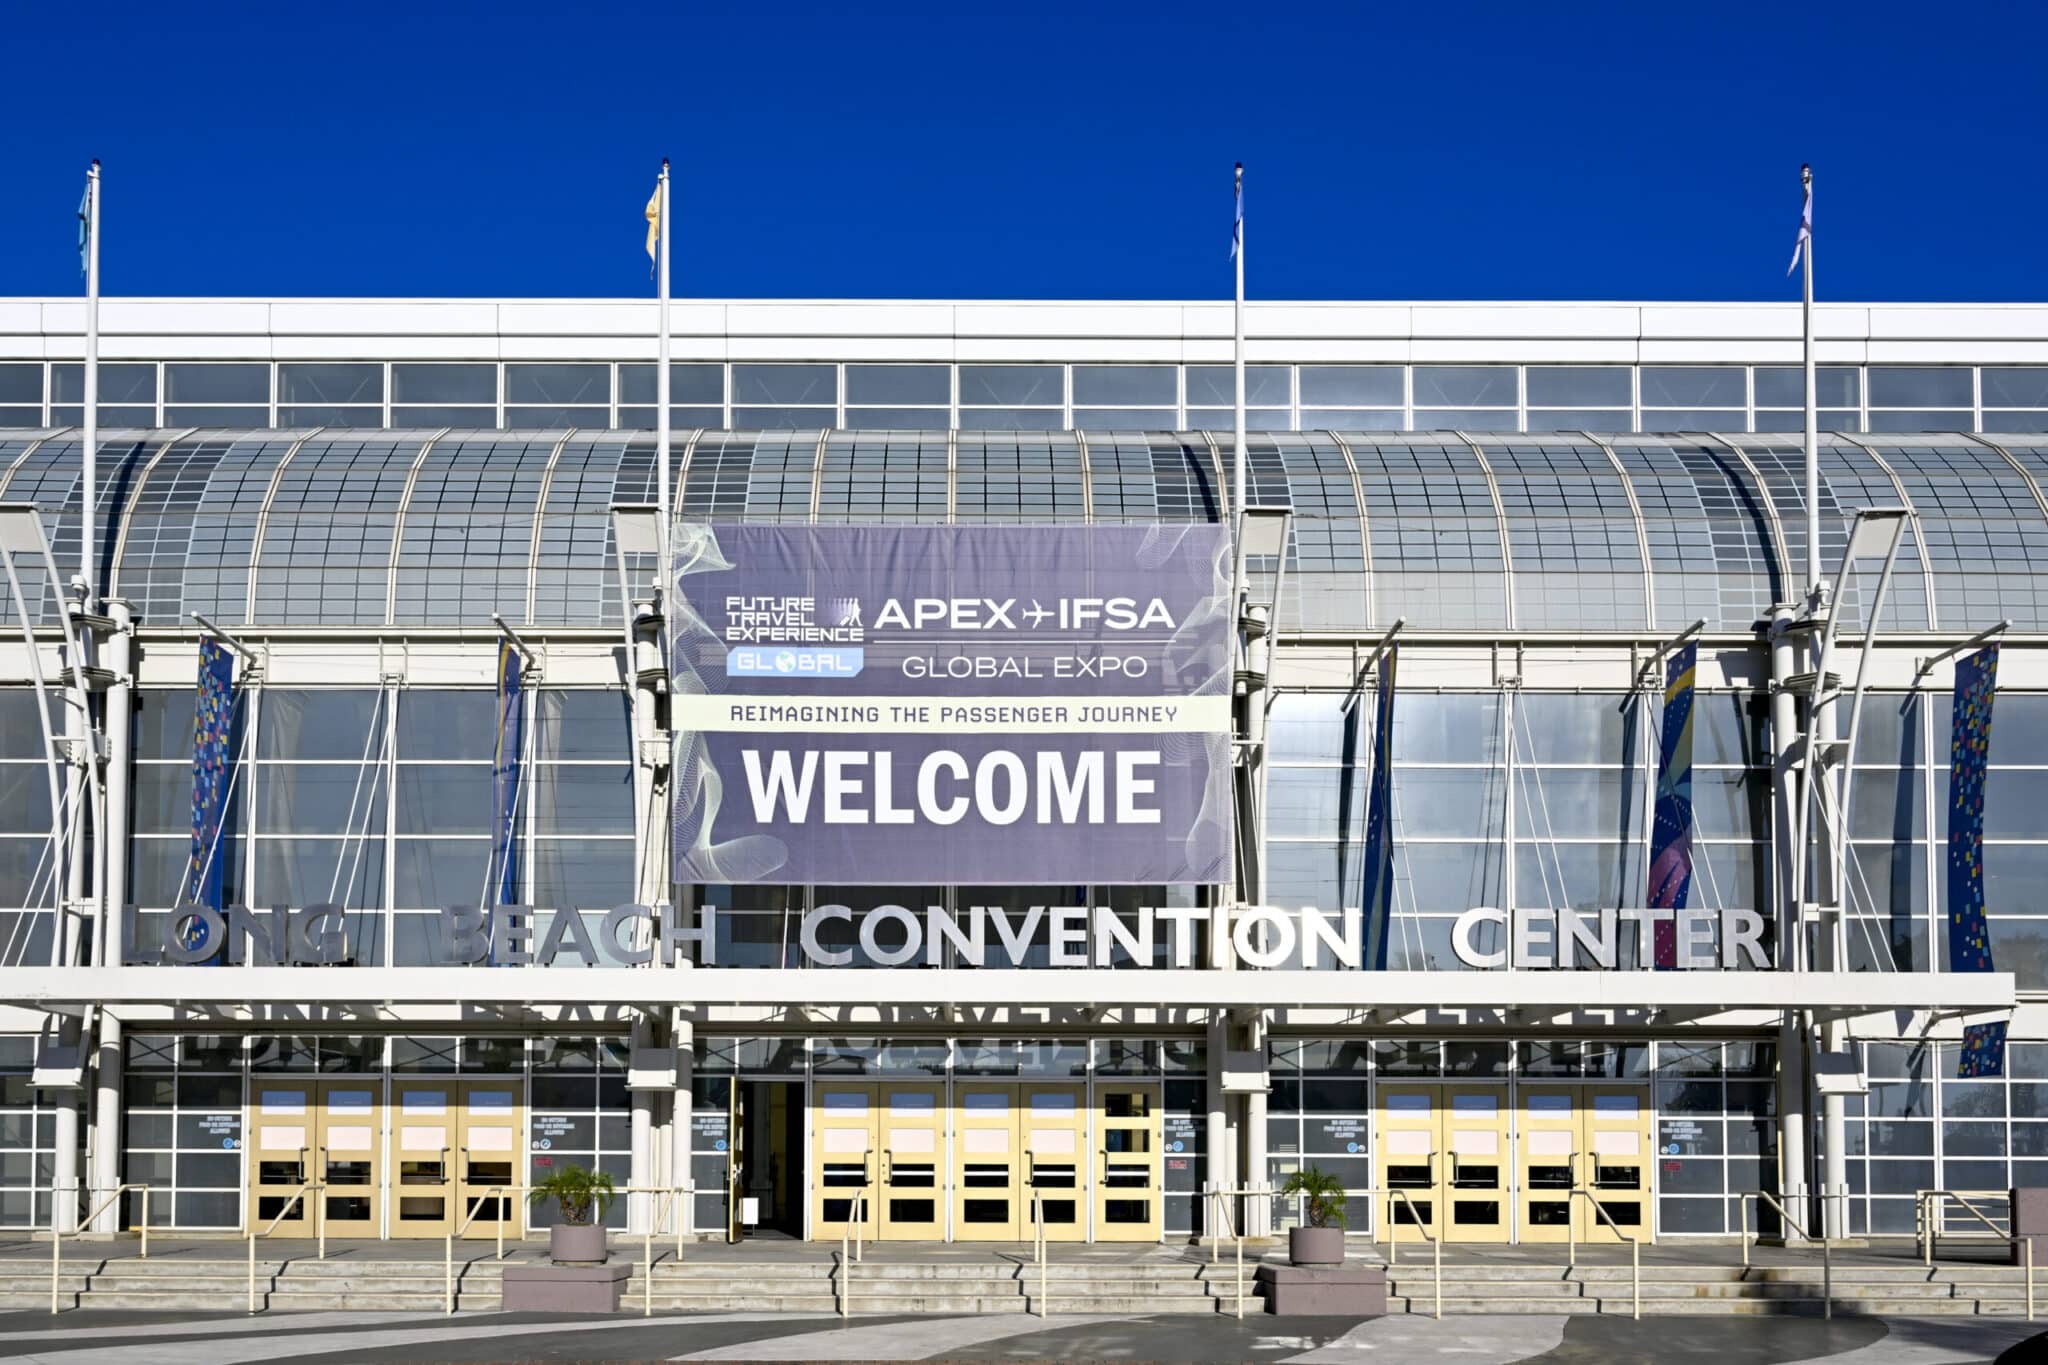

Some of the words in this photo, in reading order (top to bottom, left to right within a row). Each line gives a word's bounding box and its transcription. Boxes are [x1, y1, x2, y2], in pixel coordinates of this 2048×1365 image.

[726, 596, 815, 612] FUTURE
[873, 598, 1017, 630] APEX
[1059, 597, 1177, 630] IFSA
[726, 611, 815, 627] TRAVEL
[726, 626, 864, 643] EXPERIENCE
[902, 656, 1043, 679] GLOBAL
[1054, 656, 1148, 678] EXPO
[730, 705, 879, 723] REIMAGINING
[890, 706, 930, 723] THE
[940, 706, 1068, 723] PASSENGER
[1078, 706, 1178, 723] JOURNEY
[742, 750, 1161, 825] WELCOME
[121, 903, 348, 963] LONG
[441, 903, 716, 964] BEACH
[800, 904, 1361, 967] CONVENTION
[1451, 907, 1772, 969] CENTER
